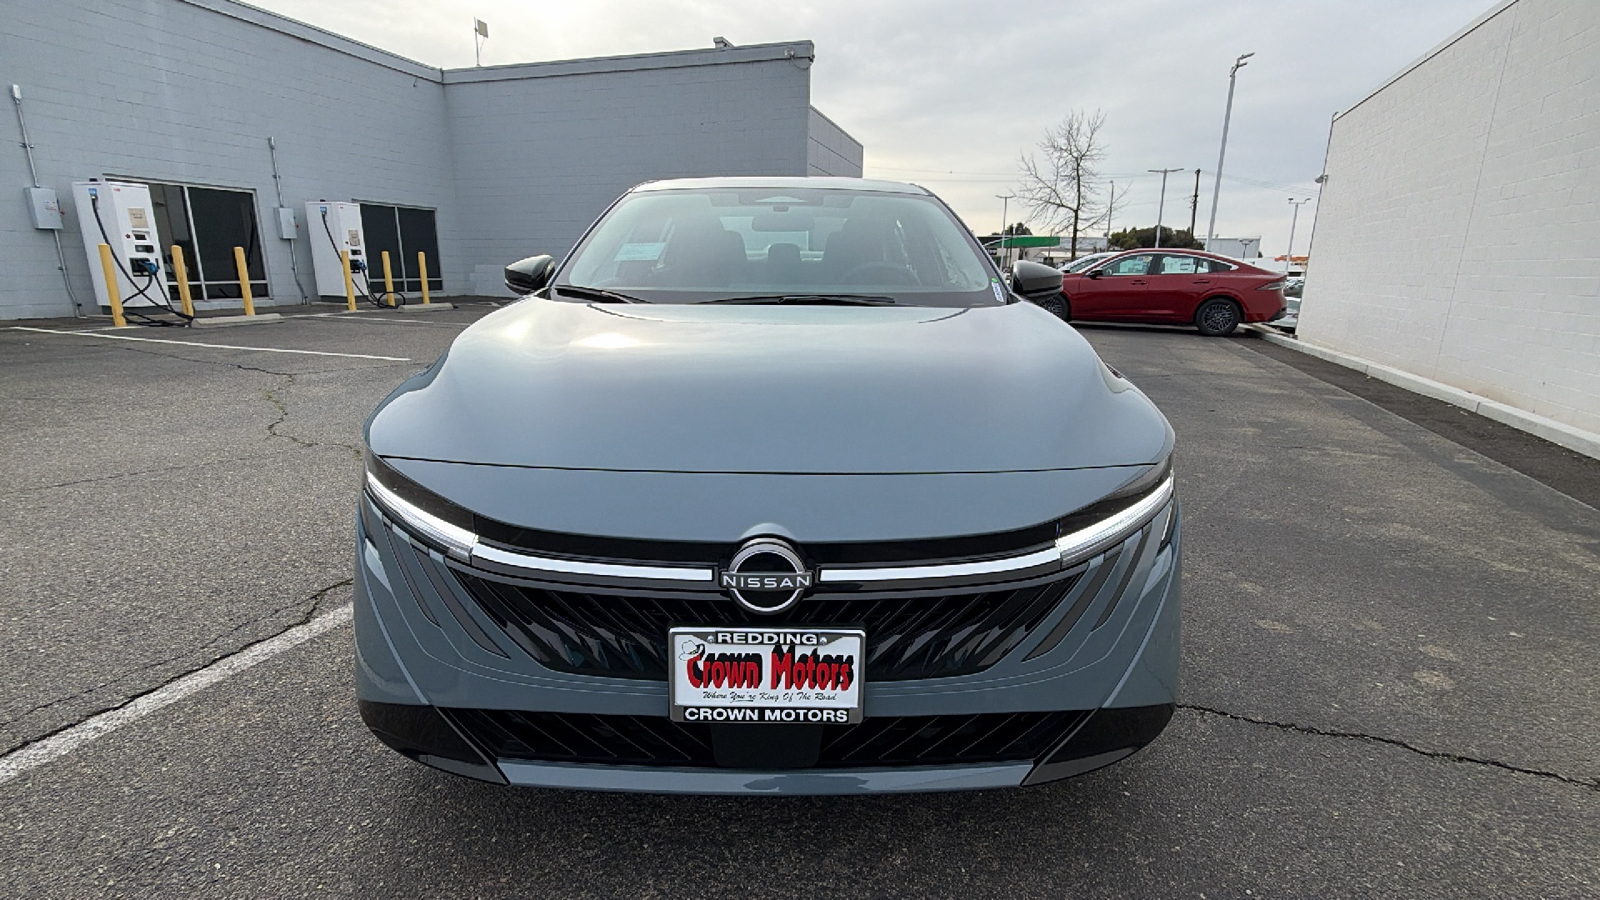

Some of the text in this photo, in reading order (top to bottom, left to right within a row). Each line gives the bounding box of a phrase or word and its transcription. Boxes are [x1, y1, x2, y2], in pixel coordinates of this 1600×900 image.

[722, 575, 810, 588] NISSAN
[717, 633, 818, 645] REDDING
[687, 644, 855, 691] Crown Motors
[702, 691, 837, 703] Where You're King Of The Road
[684, 708, 848, 722] CROWN MOTORS
